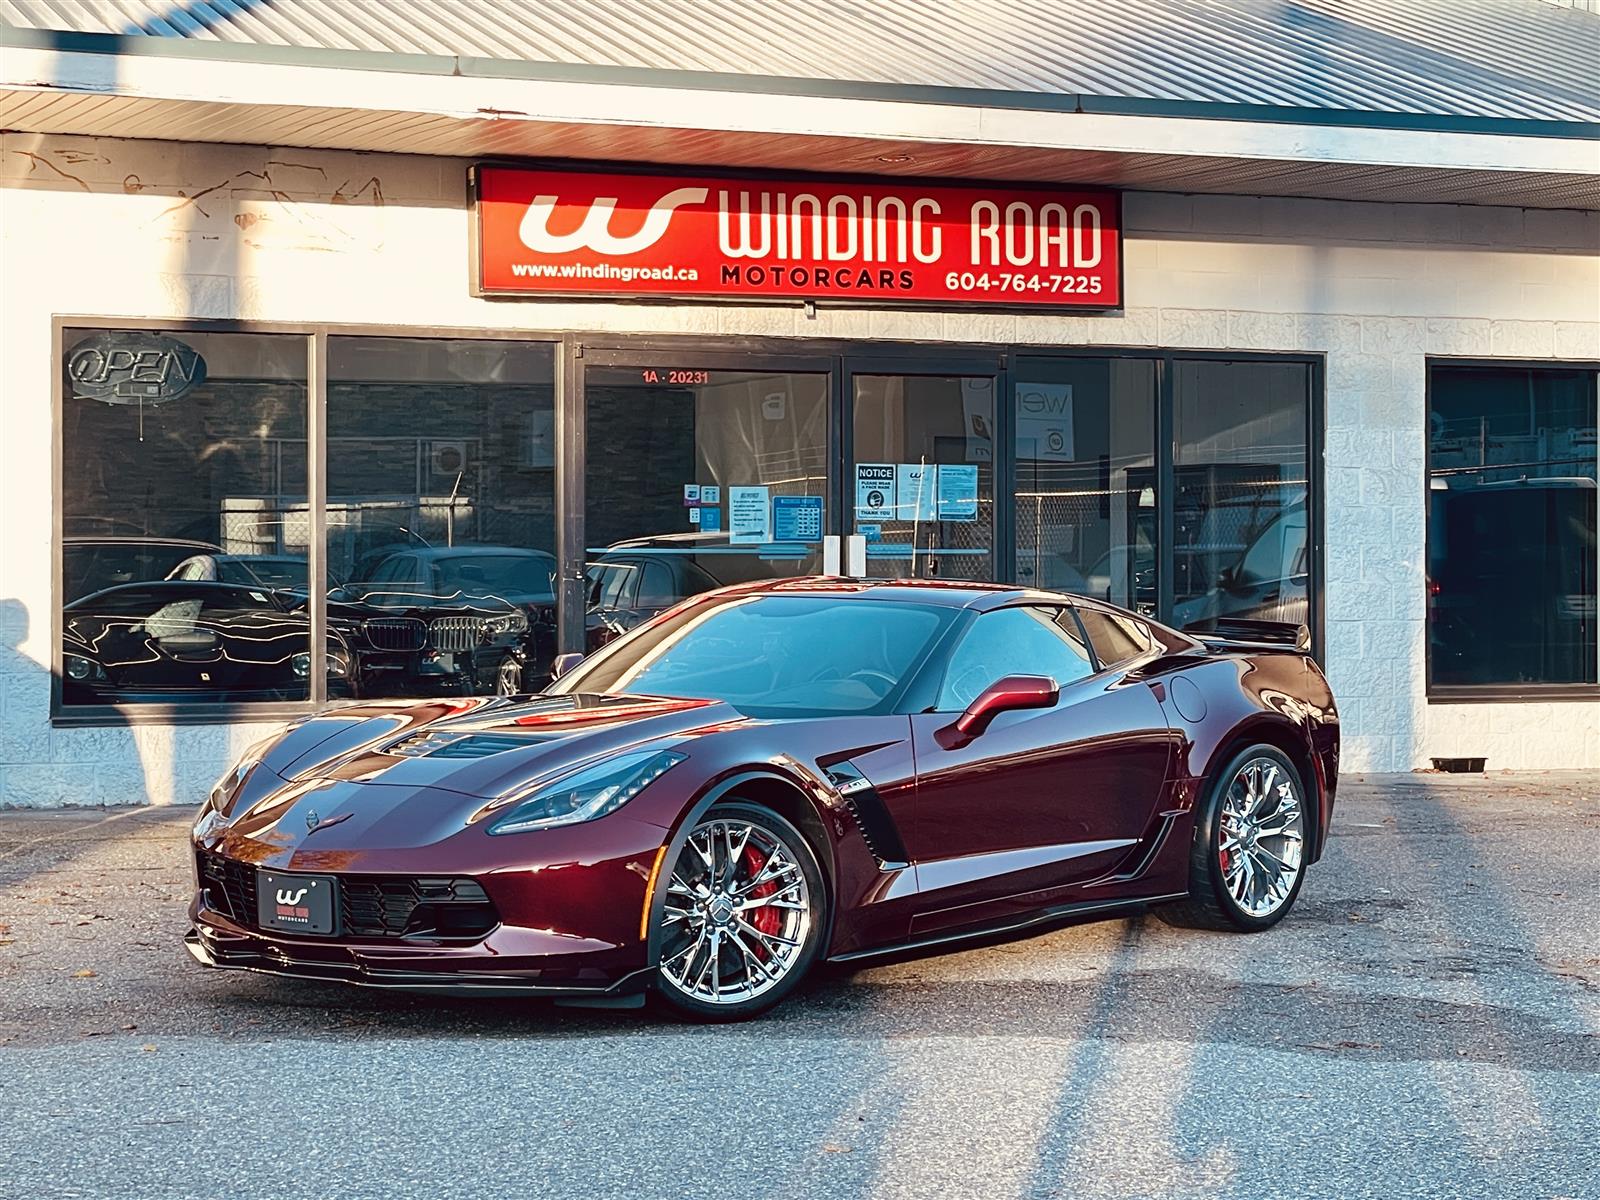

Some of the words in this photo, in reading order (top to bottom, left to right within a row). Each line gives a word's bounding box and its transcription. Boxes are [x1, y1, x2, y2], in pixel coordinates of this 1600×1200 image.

[719, 190, 942, 264] WINDING
[971, 200, 1102, 268] ROAD
[512, 263, 698, 281] www.windingroad.ca
[721, 265, 914, 290] MOTORCARS
[945, 271, 1102, 294] 604-764-7225
[69, 348, 199, 382] OPEN
[642, 370, 659, 383] 1A
[669, 371, 708, 384] 20231
[859, 468, 893, 478] NOTICE
